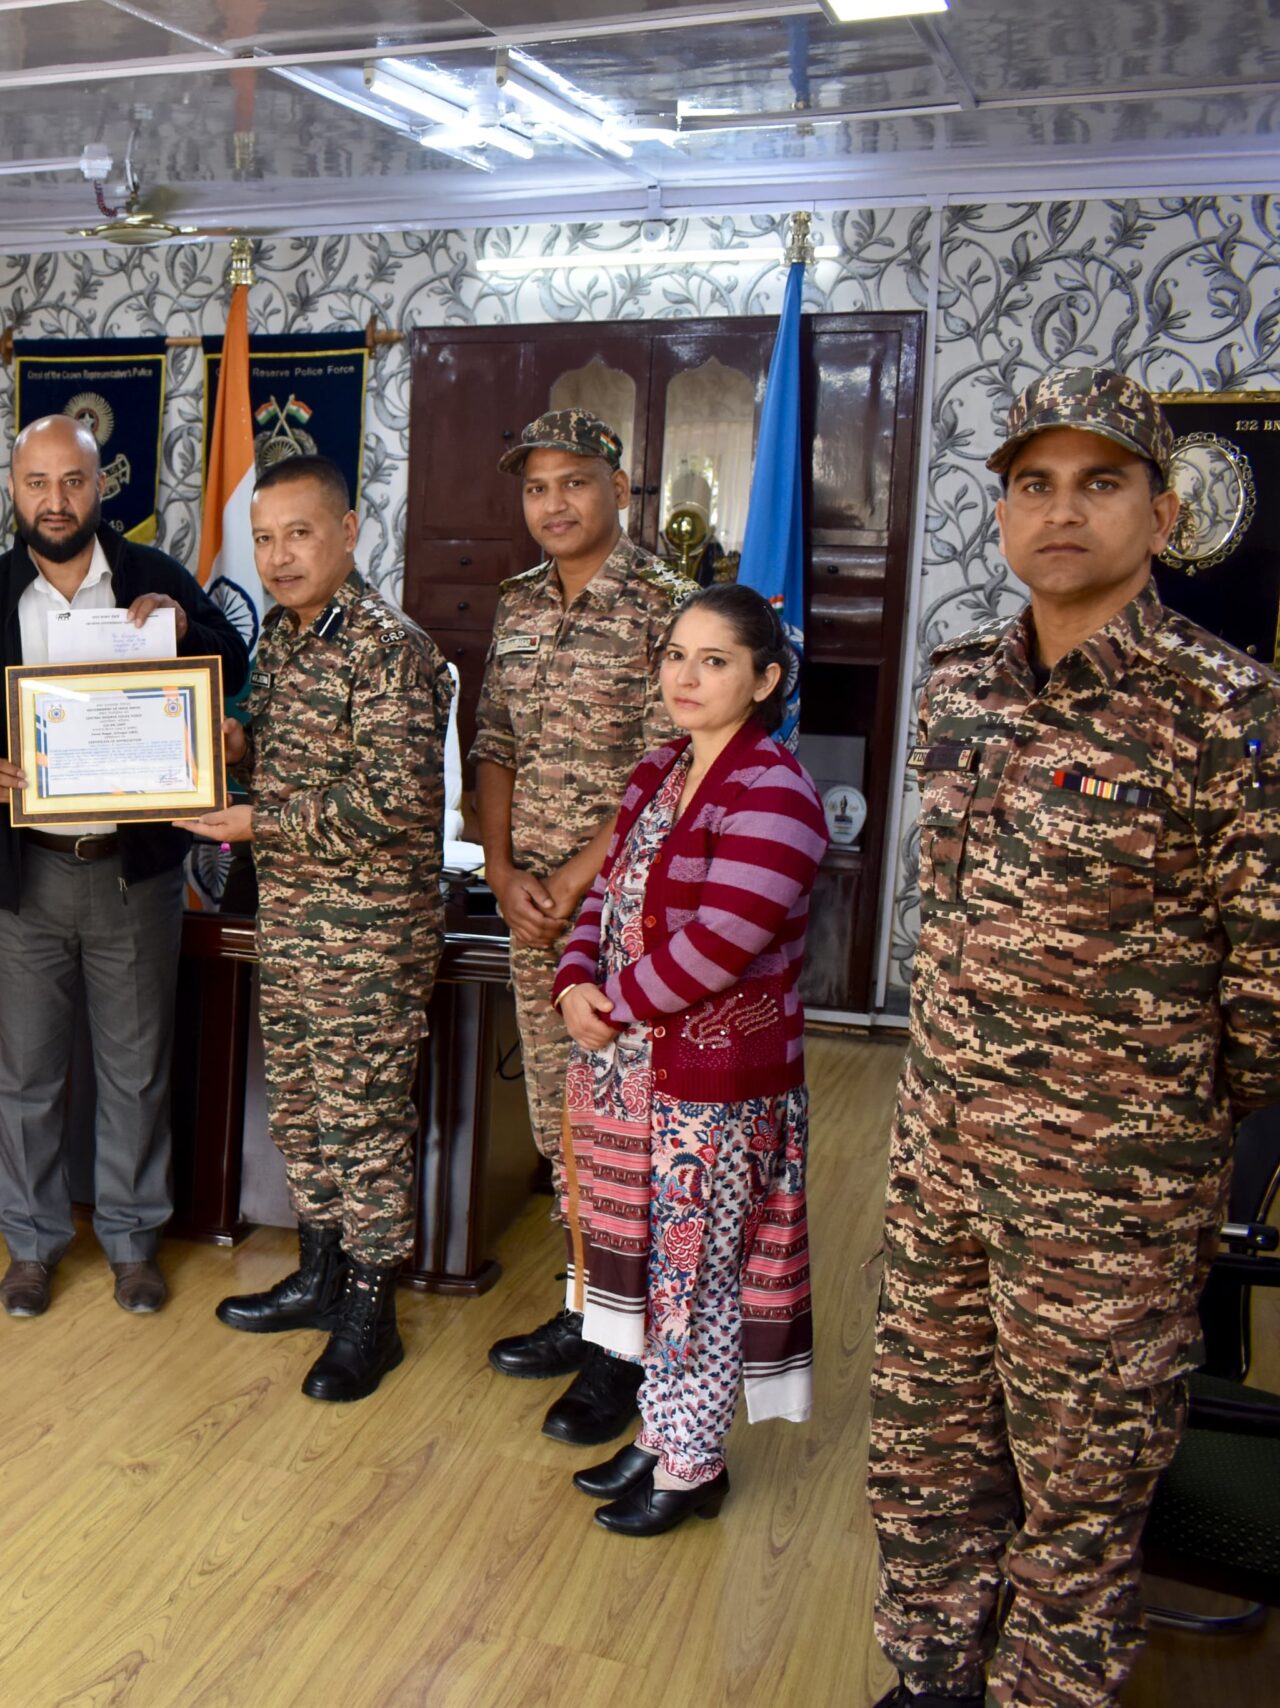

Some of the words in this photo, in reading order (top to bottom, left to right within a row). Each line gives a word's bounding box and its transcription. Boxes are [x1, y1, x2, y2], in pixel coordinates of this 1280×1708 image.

[252, 367, 290, 378] Reserve
[295, 366, 323, 377] Police
[327, 364, 355, 375] Force
[1235, 419, 1259, 431] 132
[380, 630, 407, 644] CRP
